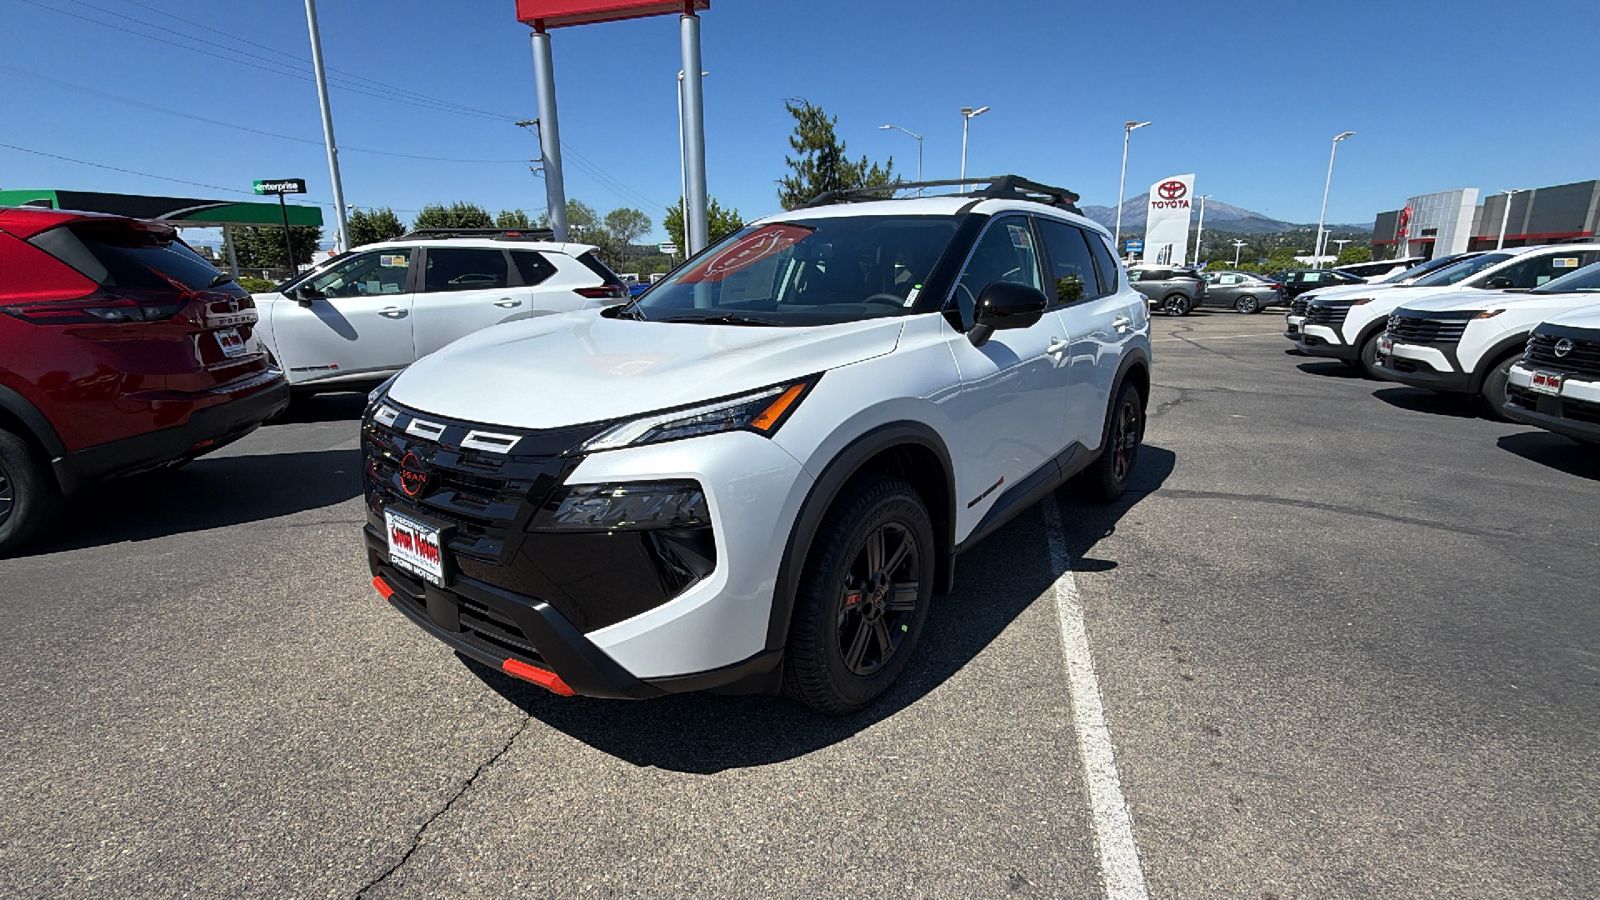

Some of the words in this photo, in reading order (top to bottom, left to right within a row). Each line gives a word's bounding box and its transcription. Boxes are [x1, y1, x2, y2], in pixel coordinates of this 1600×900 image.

[254, 181, 298, 192] enterprise
[1152, 200, 1190, 209] TOYOTA
[400, 469, 427, 483] SSAN
[391, 555, 413, 571] CROWN
[413, 566, 439, 584] MOTORS
